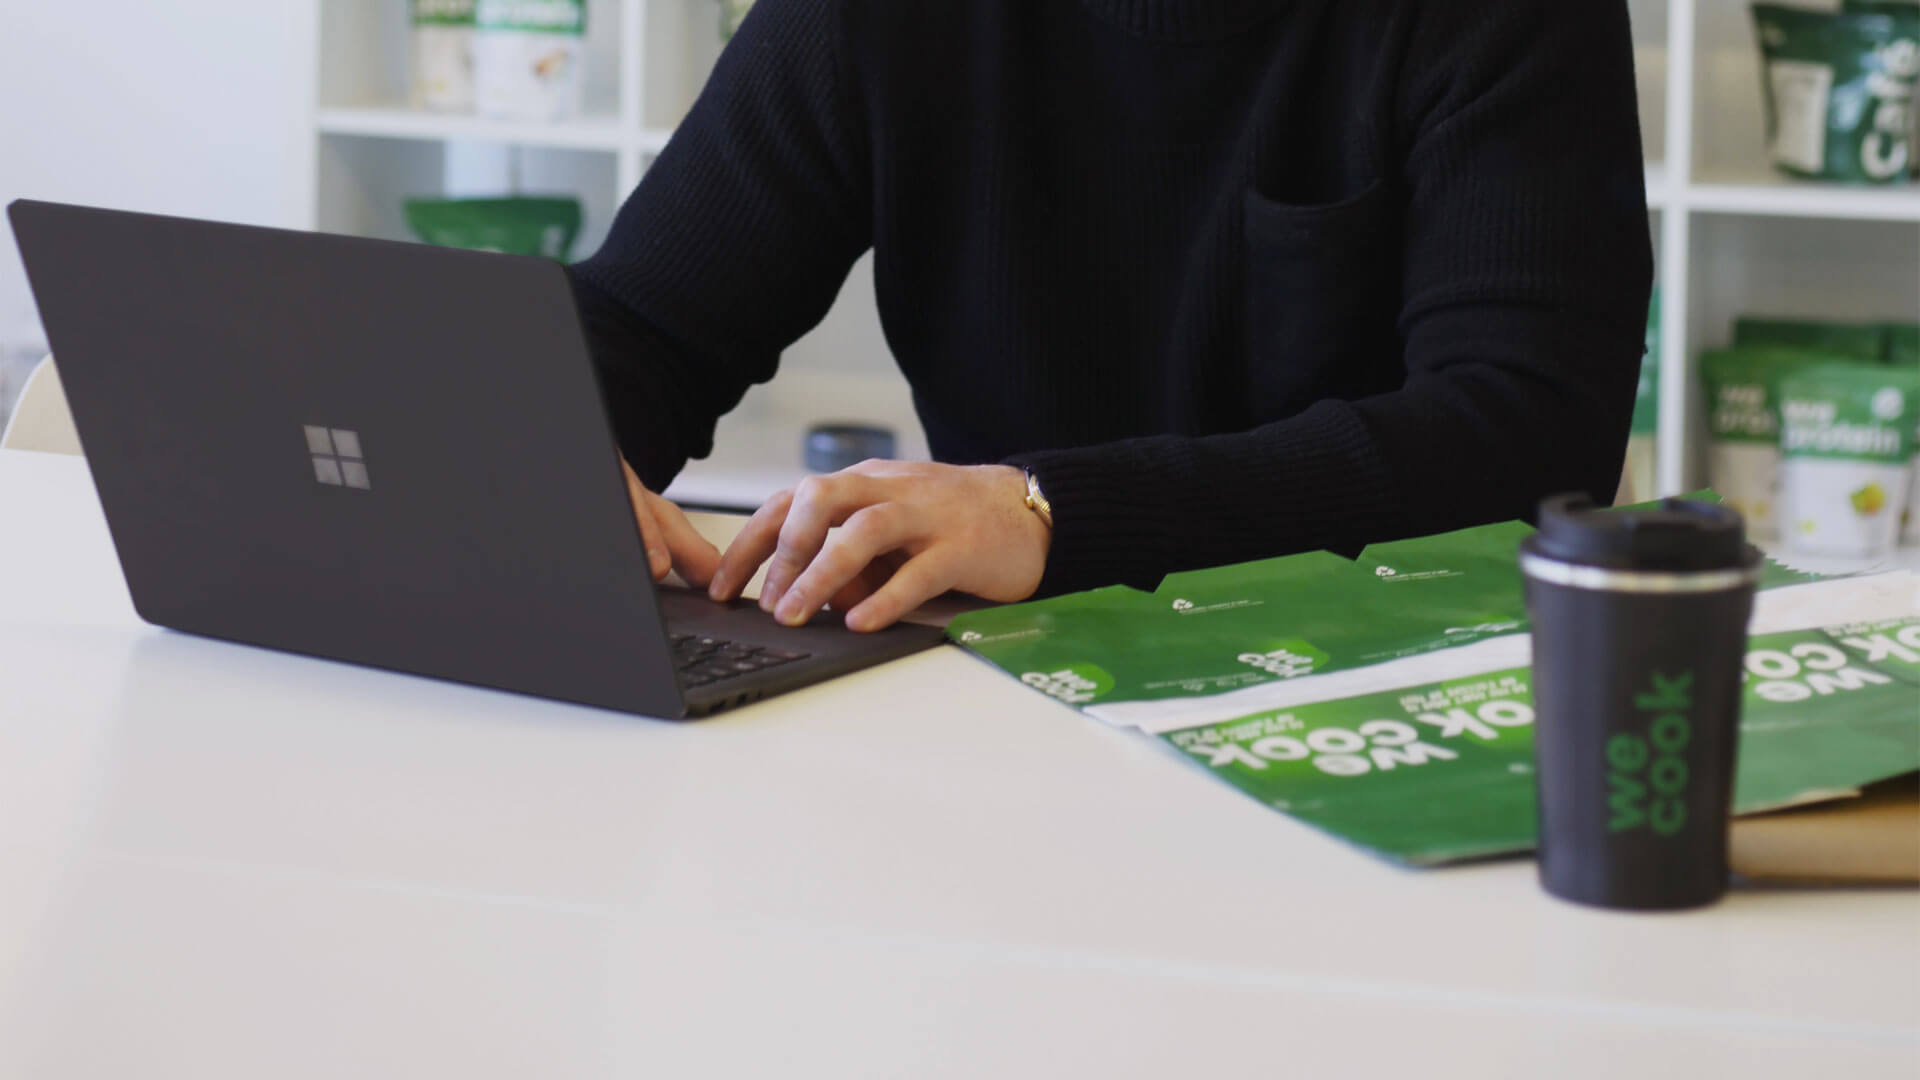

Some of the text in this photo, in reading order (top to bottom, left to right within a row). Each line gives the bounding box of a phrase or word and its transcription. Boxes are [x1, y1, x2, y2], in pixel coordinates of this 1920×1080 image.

[1753, 666, 1894, 703] we
[1185, 718, 1419, 770] cook
[1312, 740, 1460, 777] we
[1634, 669, 1695, 836] cook
[1605, 732, 1648, 834] we
